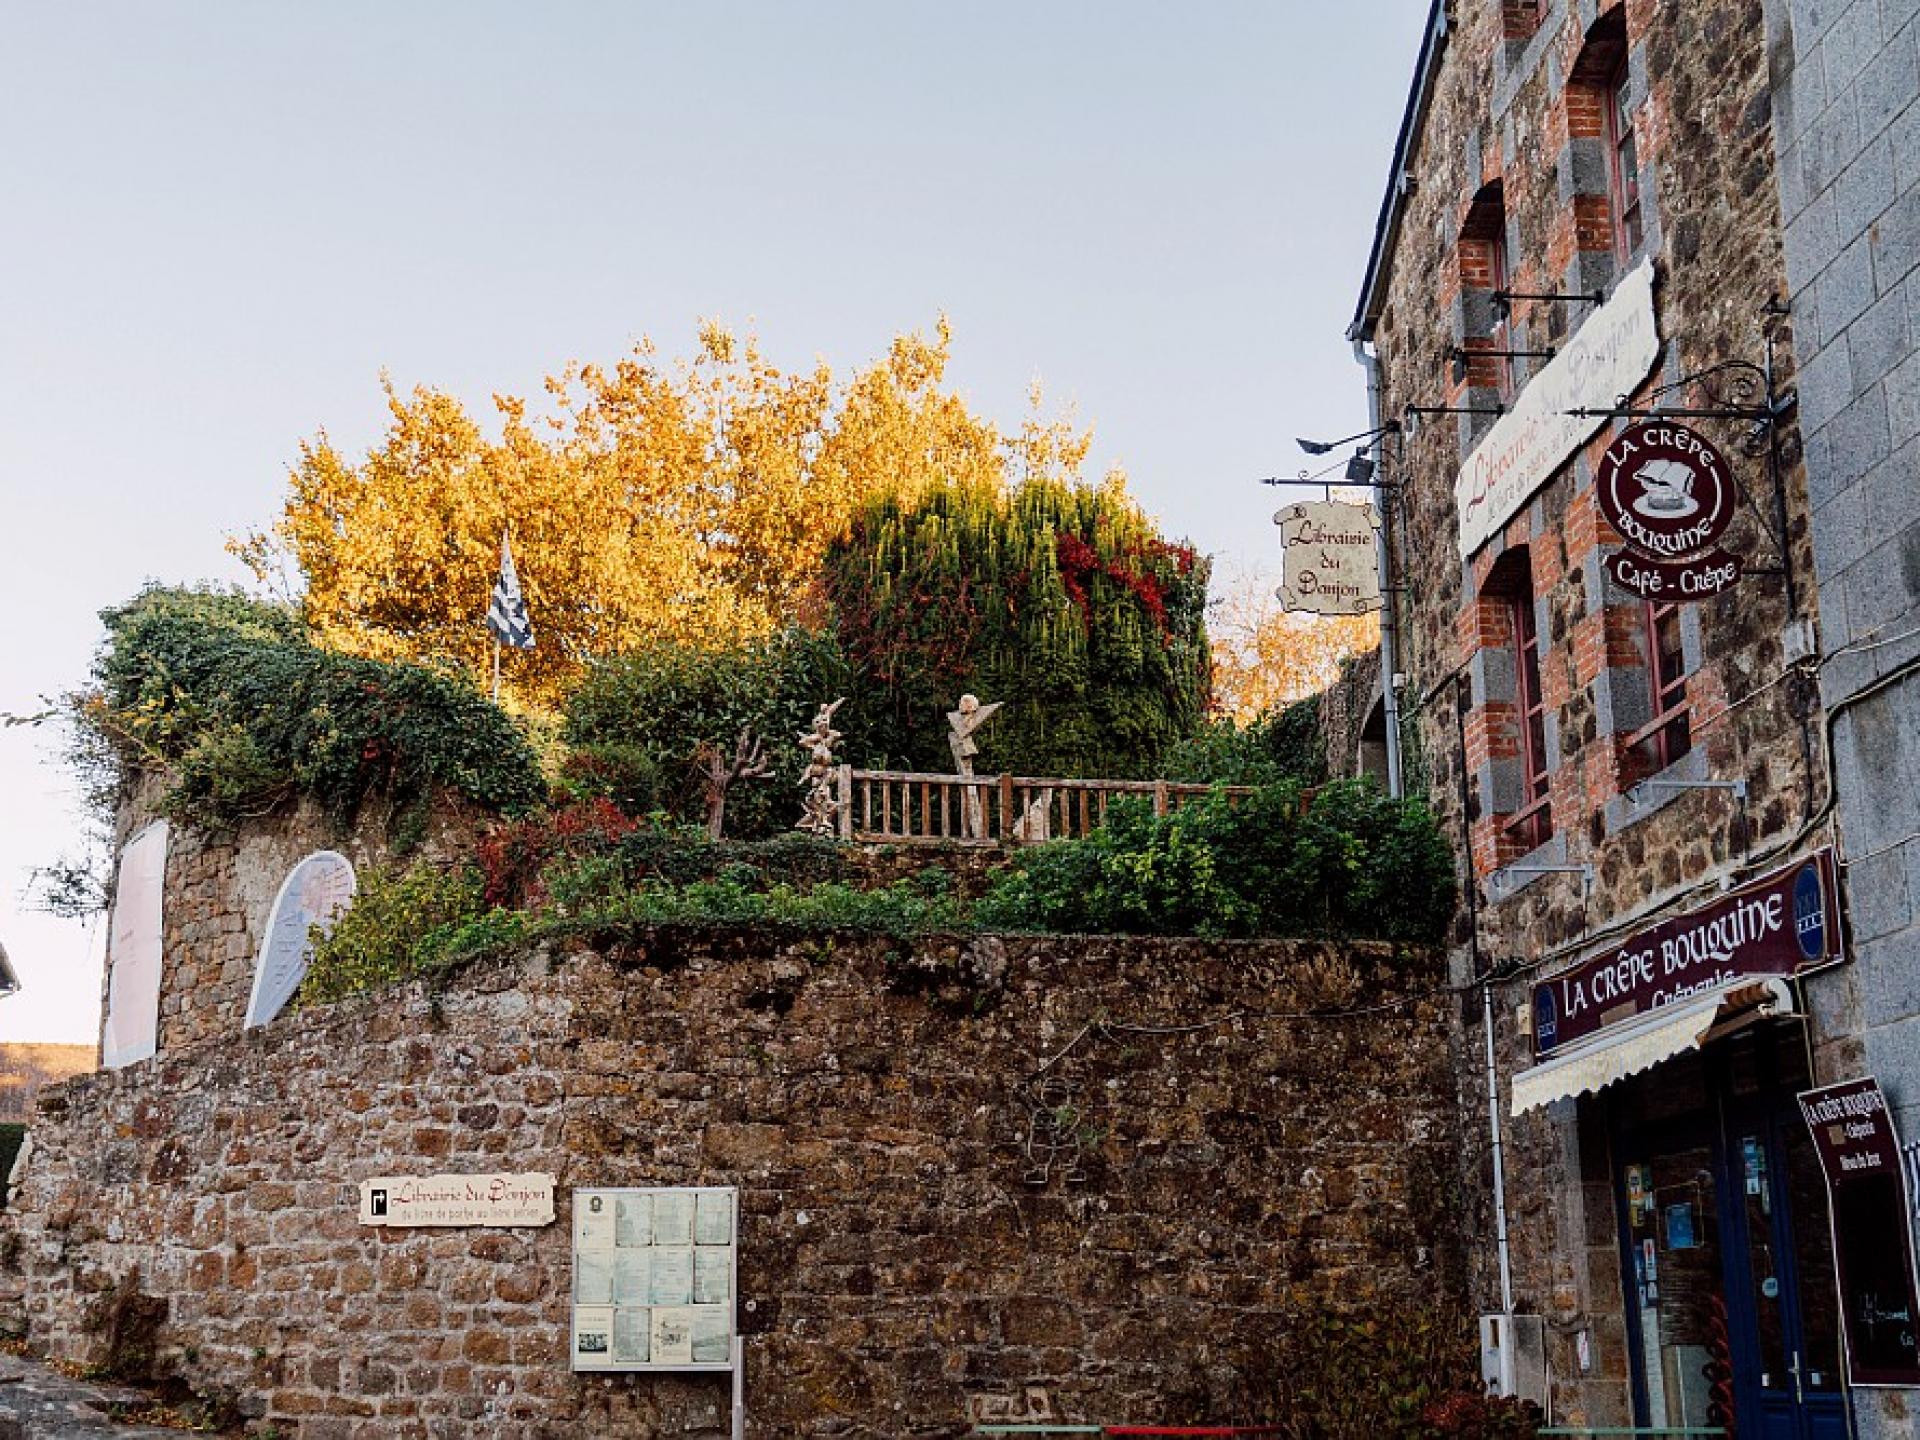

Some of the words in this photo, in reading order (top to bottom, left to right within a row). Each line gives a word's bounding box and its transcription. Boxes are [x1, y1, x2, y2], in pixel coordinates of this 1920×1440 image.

[1606, 439, 1639, 467] LA
[1643, 428, 1716, 468] CRÊPE
[1288, 520, 1370, 546] Librairie
[1618, 510, 1715, 557] BOUQUINE
[1320, 550, 1340, 569] du
[1297, 569, 1361, 603] Donjon
[1616, 560, 1662, 595] Café
[1679, 562, 1737, 593] Crêpe
[1562, 979, 1588, 1019] LA
[1591, 949, 1655, 1004] CRÊPE
[1661, 892, 1784, 976] BOUQUINE
[391, 1180, 462, 1208] Librairie
[466, 1182, 485, 1202] du
[488, 1177, 546, 1208] Donjon
